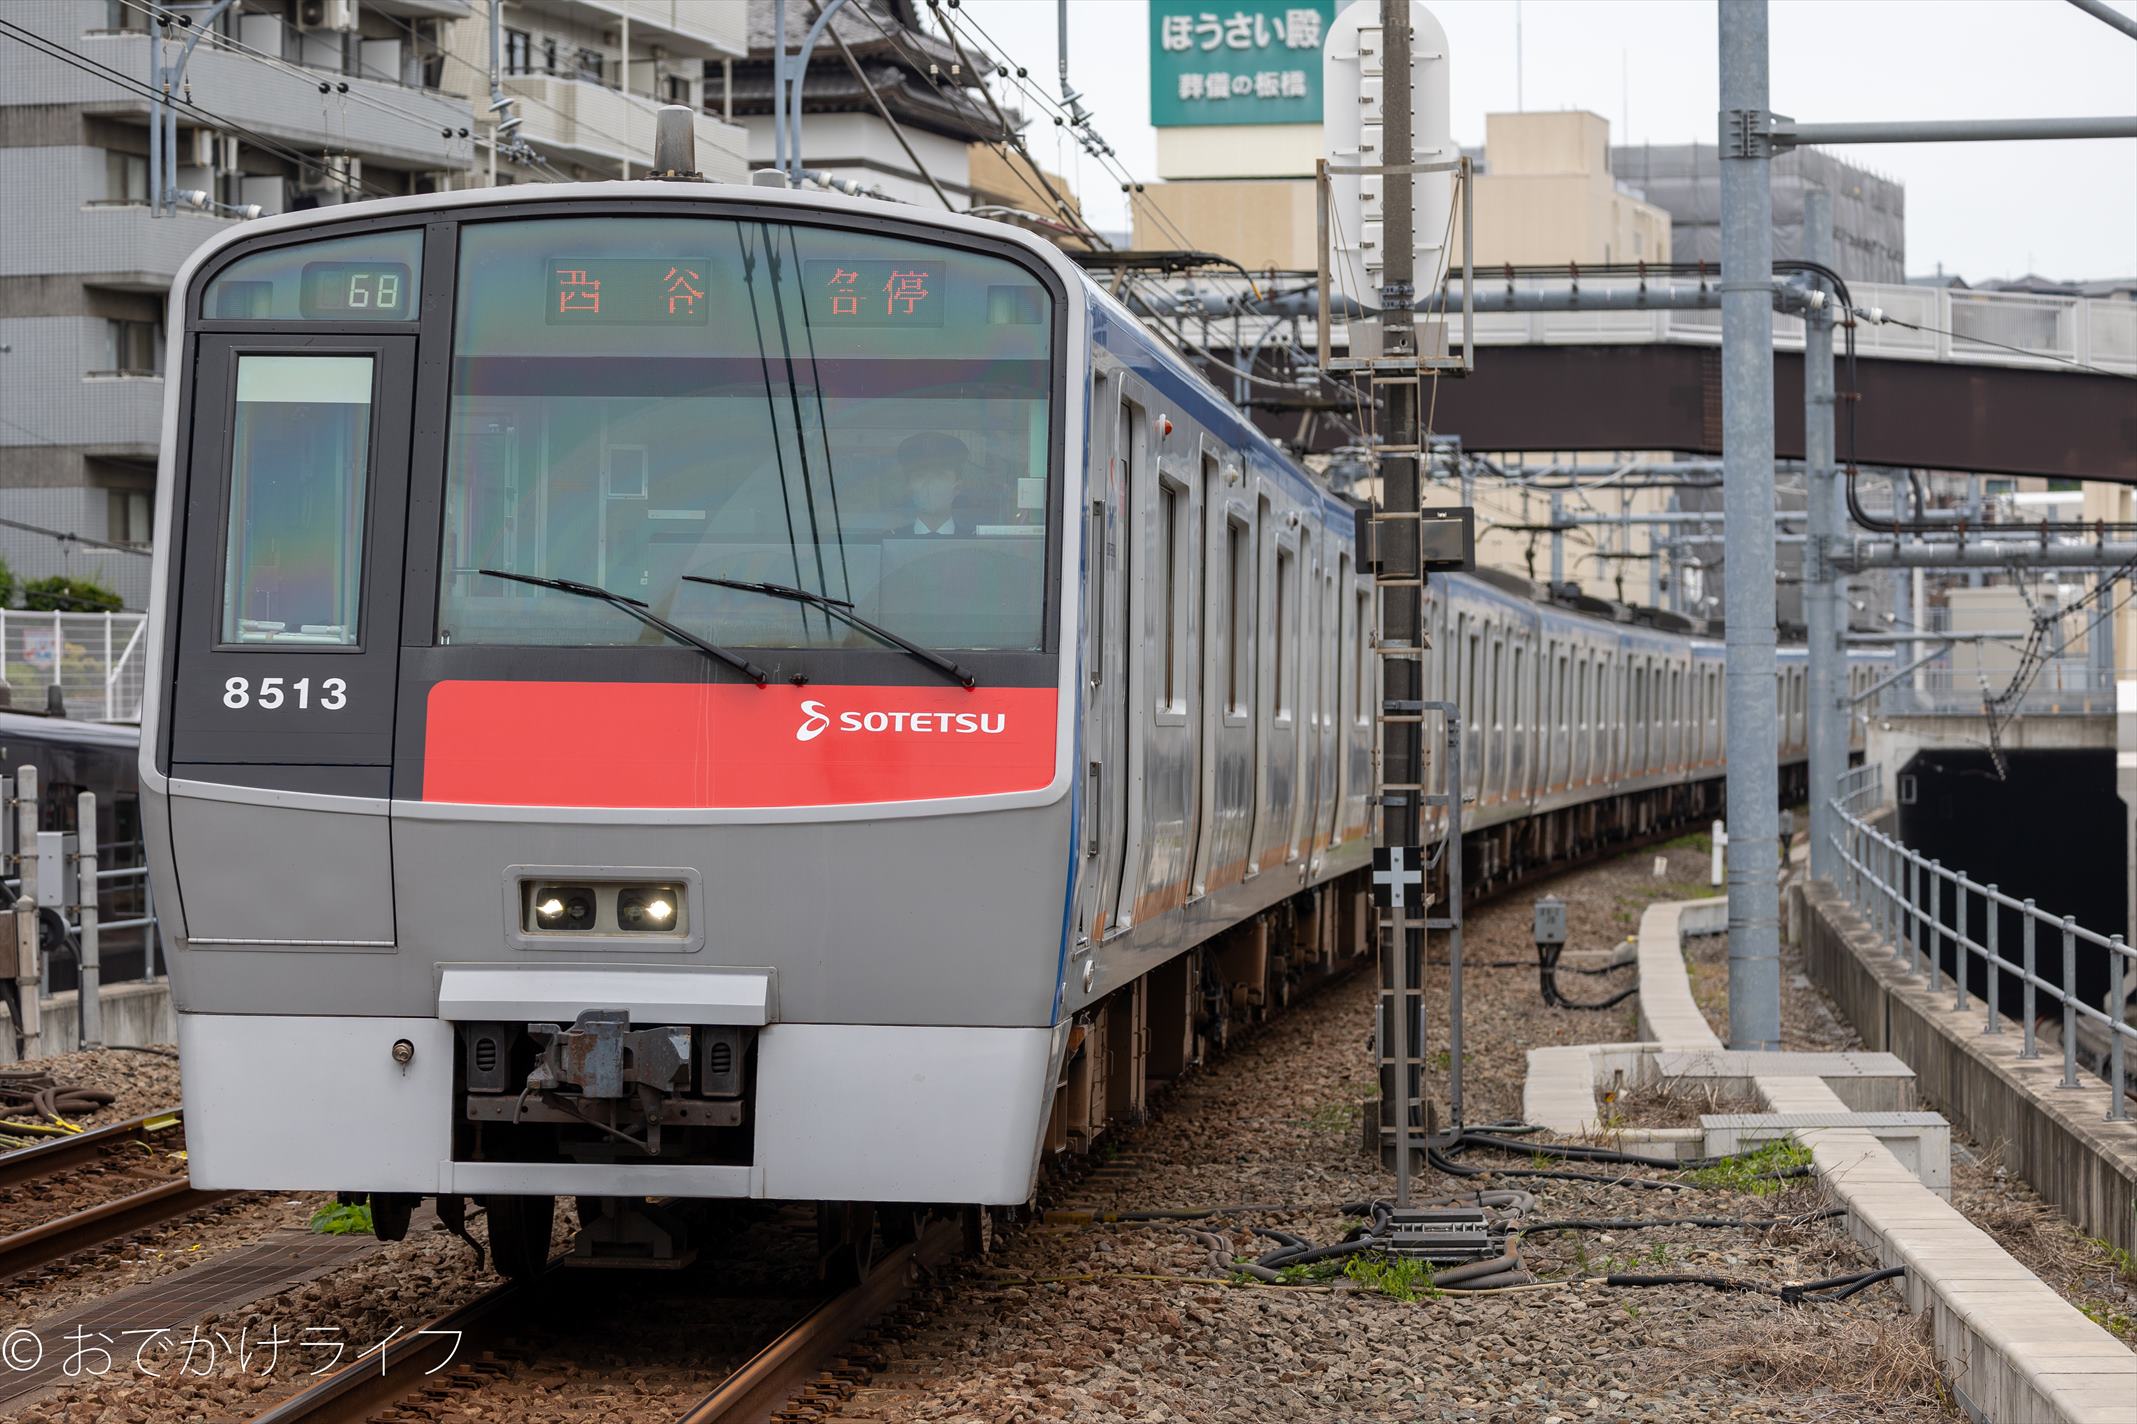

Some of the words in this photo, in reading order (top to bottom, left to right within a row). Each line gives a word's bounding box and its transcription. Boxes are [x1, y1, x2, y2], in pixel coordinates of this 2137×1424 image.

[1161, 8, 1322, 51] ほうさい殿
[1178, 70, 1307, 100] 葬儀の板橋
[349, 273, 399, 308] 68
[223, 676, 347, 710] 8513
[839, 711, 1006, 734] SOTETSU
